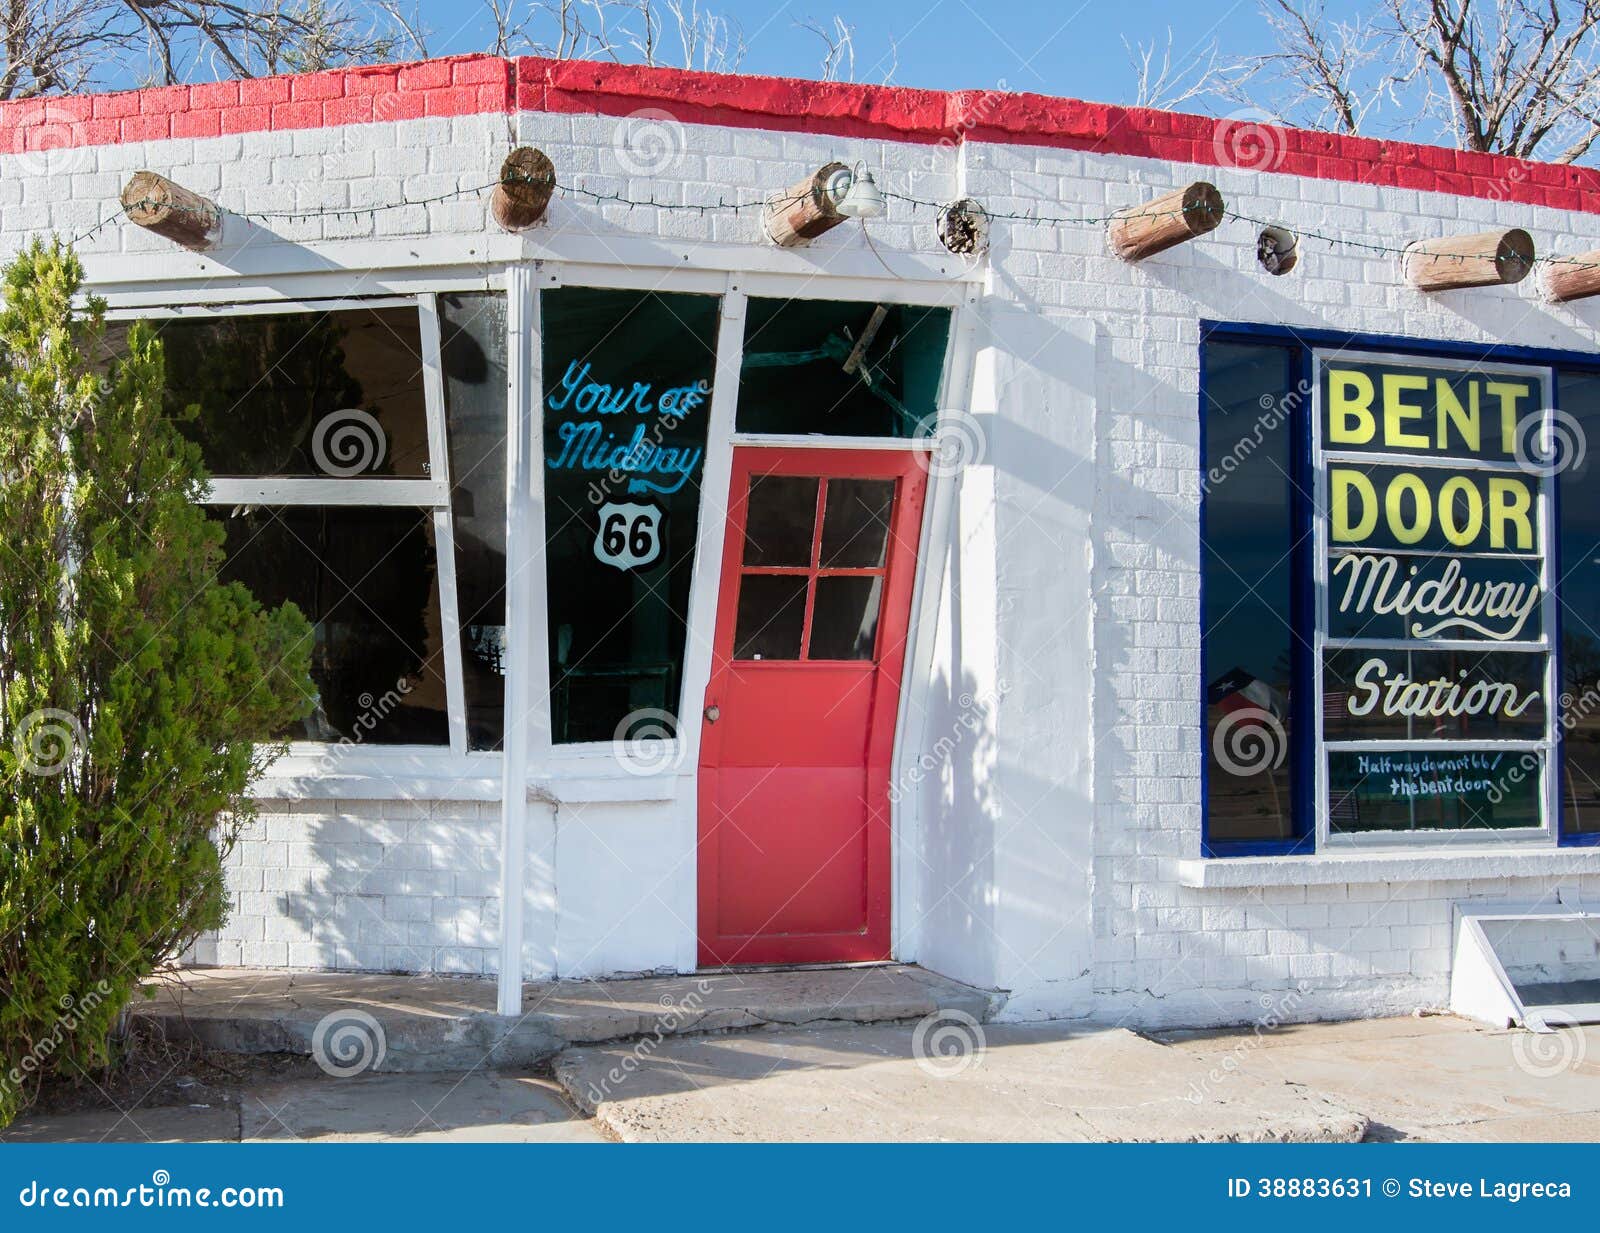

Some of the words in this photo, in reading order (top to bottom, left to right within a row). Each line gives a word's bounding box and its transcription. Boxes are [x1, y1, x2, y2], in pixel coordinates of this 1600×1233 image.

[548, 359, 652, 414] Your
[1329, 369, 1529, 453] BENT
[547, 421, 702, 494] Midway
[603, 513, 653, 558] 66
[1331, 469, 1533, 550] DOOR
[1333, 554, 1539, 640] Midway
[1348, 658, 1540, 717] Station
